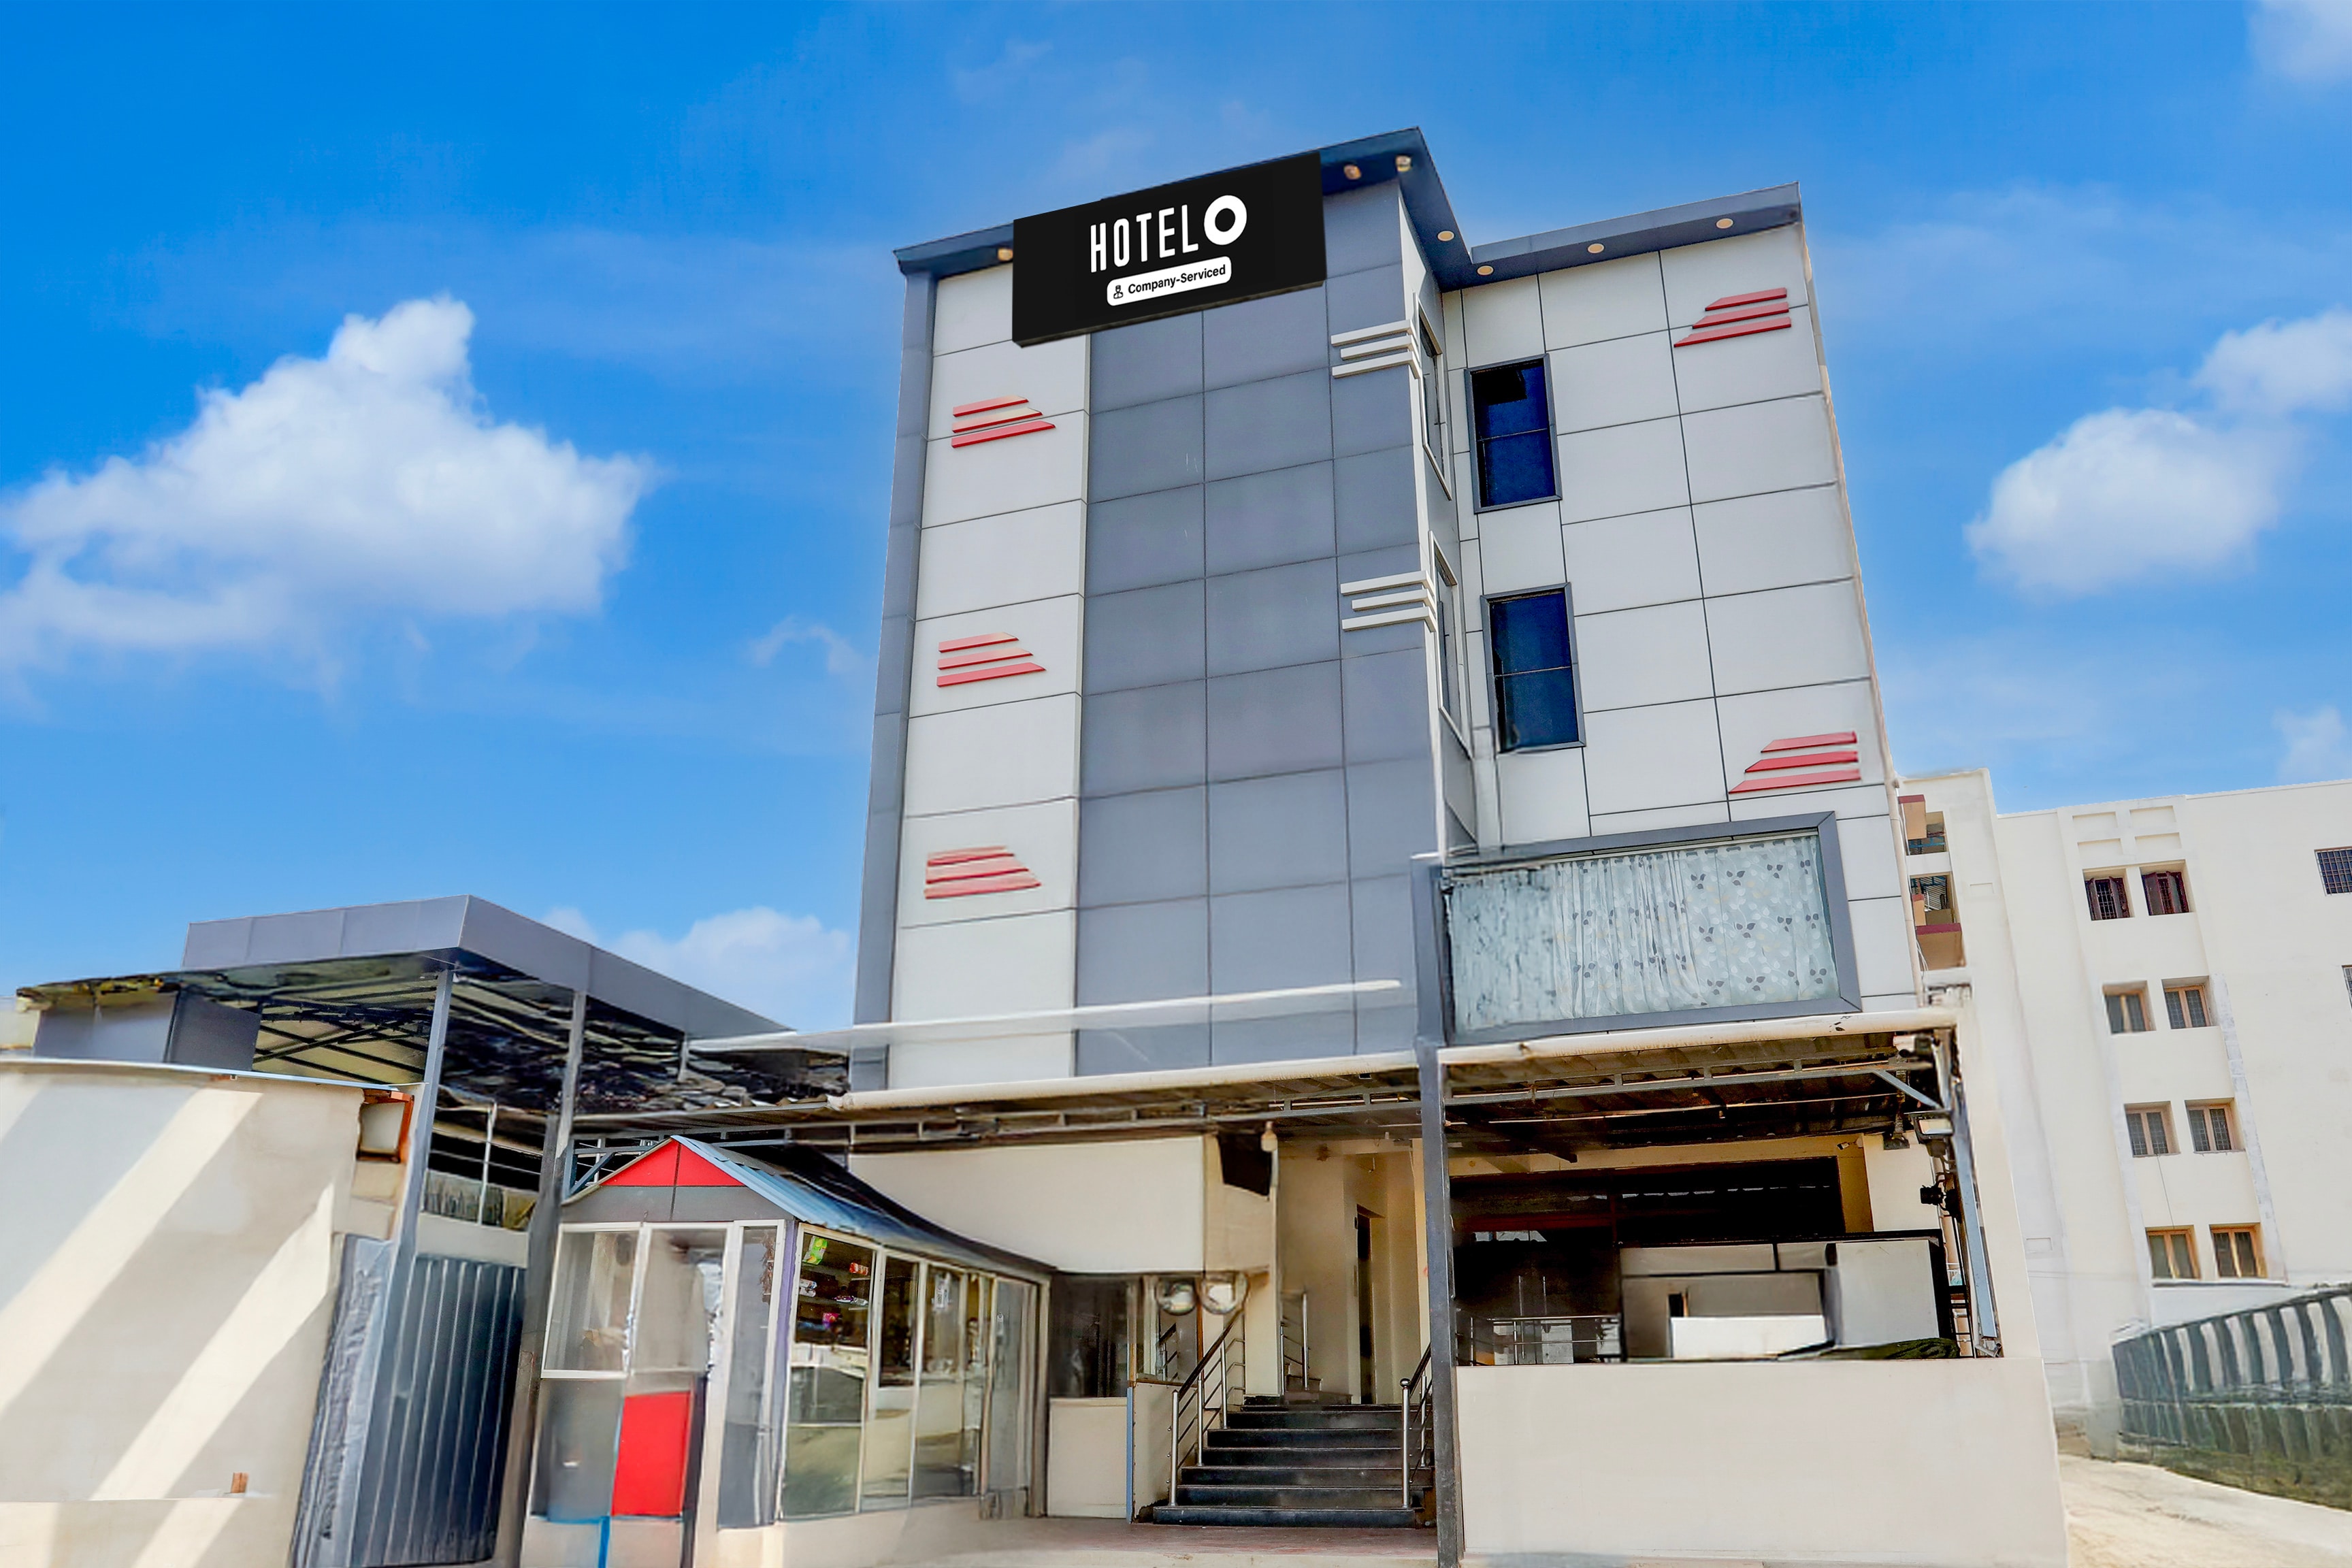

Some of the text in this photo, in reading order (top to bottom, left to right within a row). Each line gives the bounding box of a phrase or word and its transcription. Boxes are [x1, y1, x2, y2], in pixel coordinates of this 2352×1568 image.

[1090, 195, 1247, 273] HOTEL O
[1128, 264, 1226, 294] Company-Serviced
